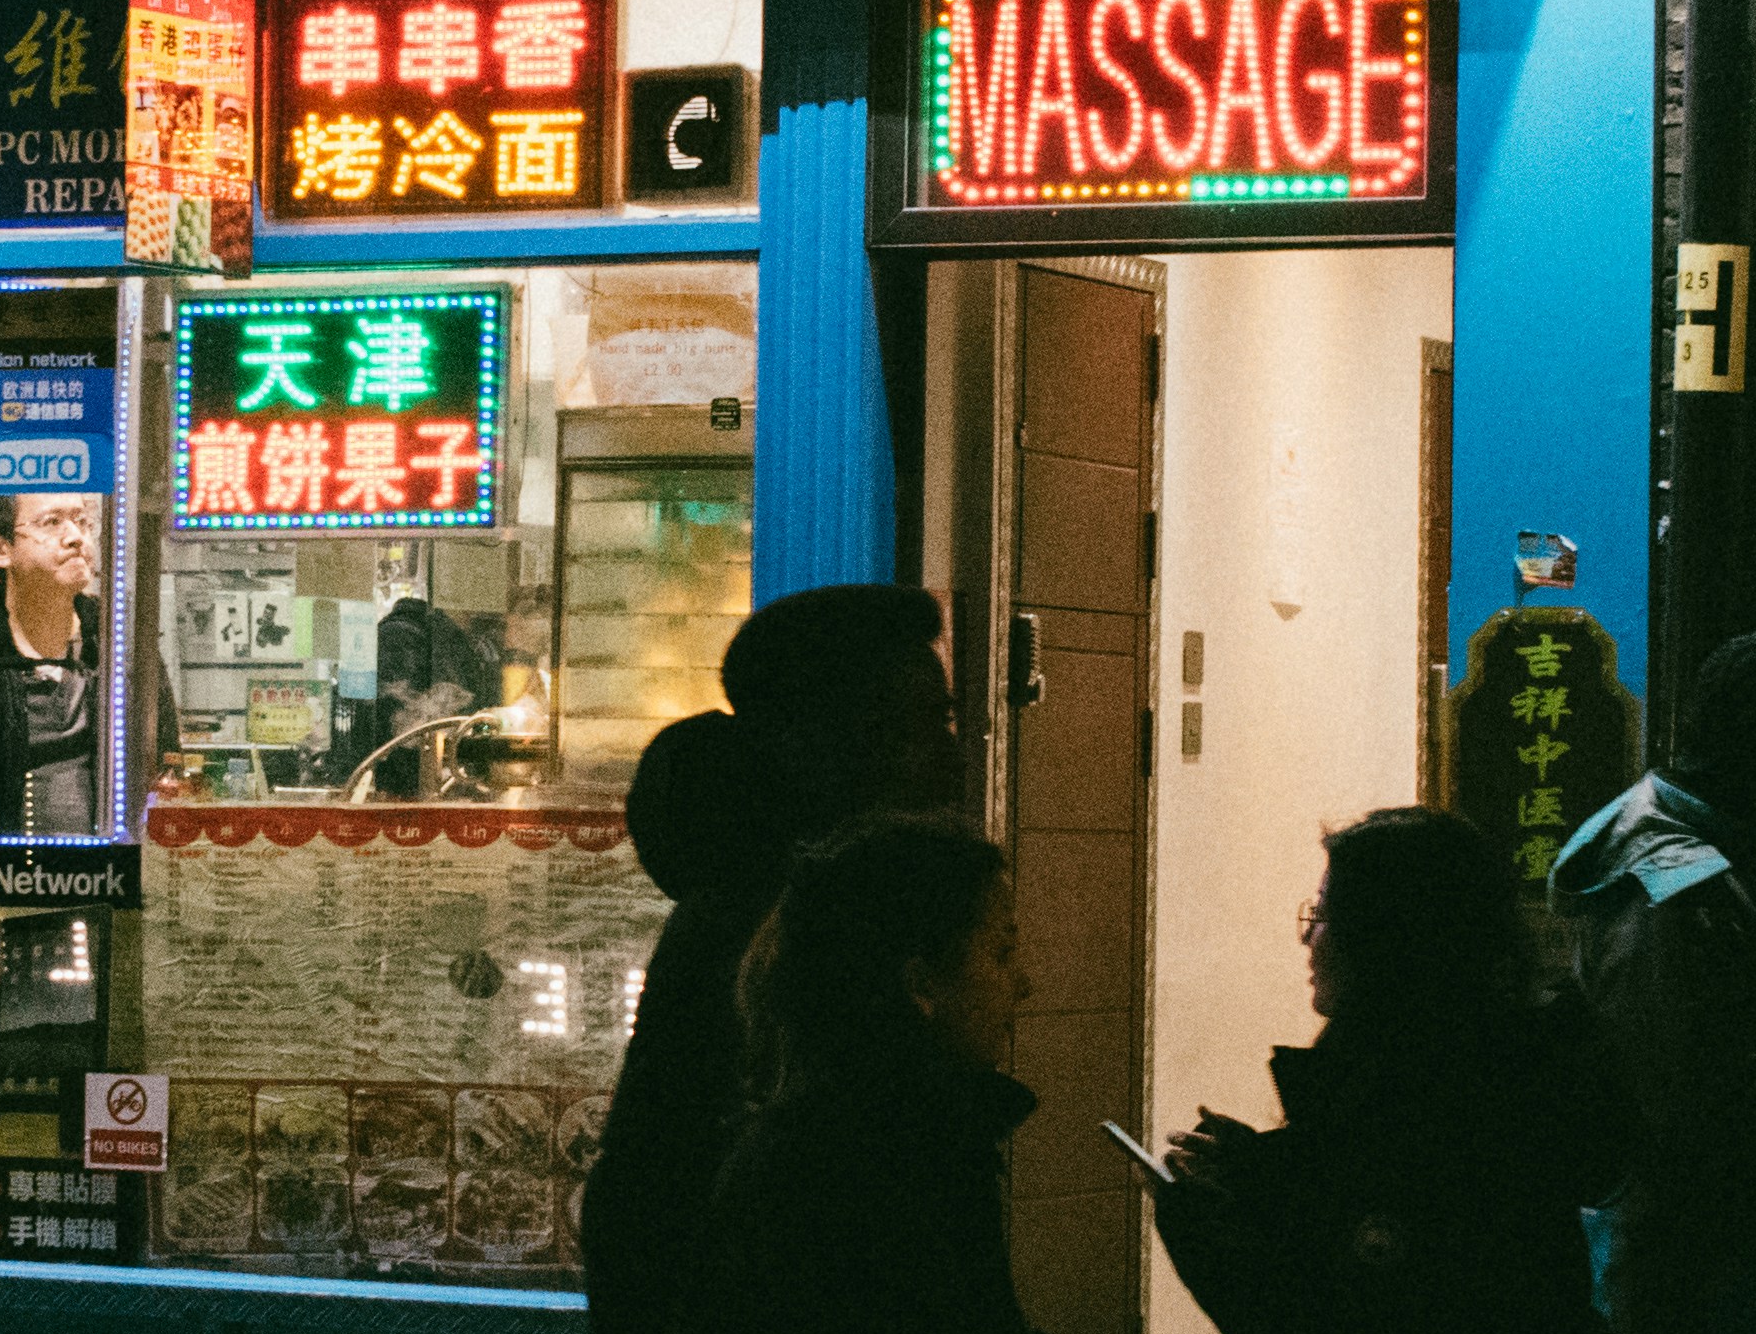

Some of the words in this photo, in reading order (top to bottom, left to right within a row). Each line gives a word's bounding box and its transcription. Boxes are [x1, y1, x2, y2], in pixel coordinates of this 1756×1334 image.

[292, 110, 586, 200] 烤冷面
[29, 352, 98, 368] network
[239, 313, 431, 412] 天津
[188, 419, 485, 514] 煎饼果子
[93, 1139, 114, 1154] NO
[117, 1140, 159, 1156] BIKES
[7, 1214, 118, 1254] 手機解鎖
